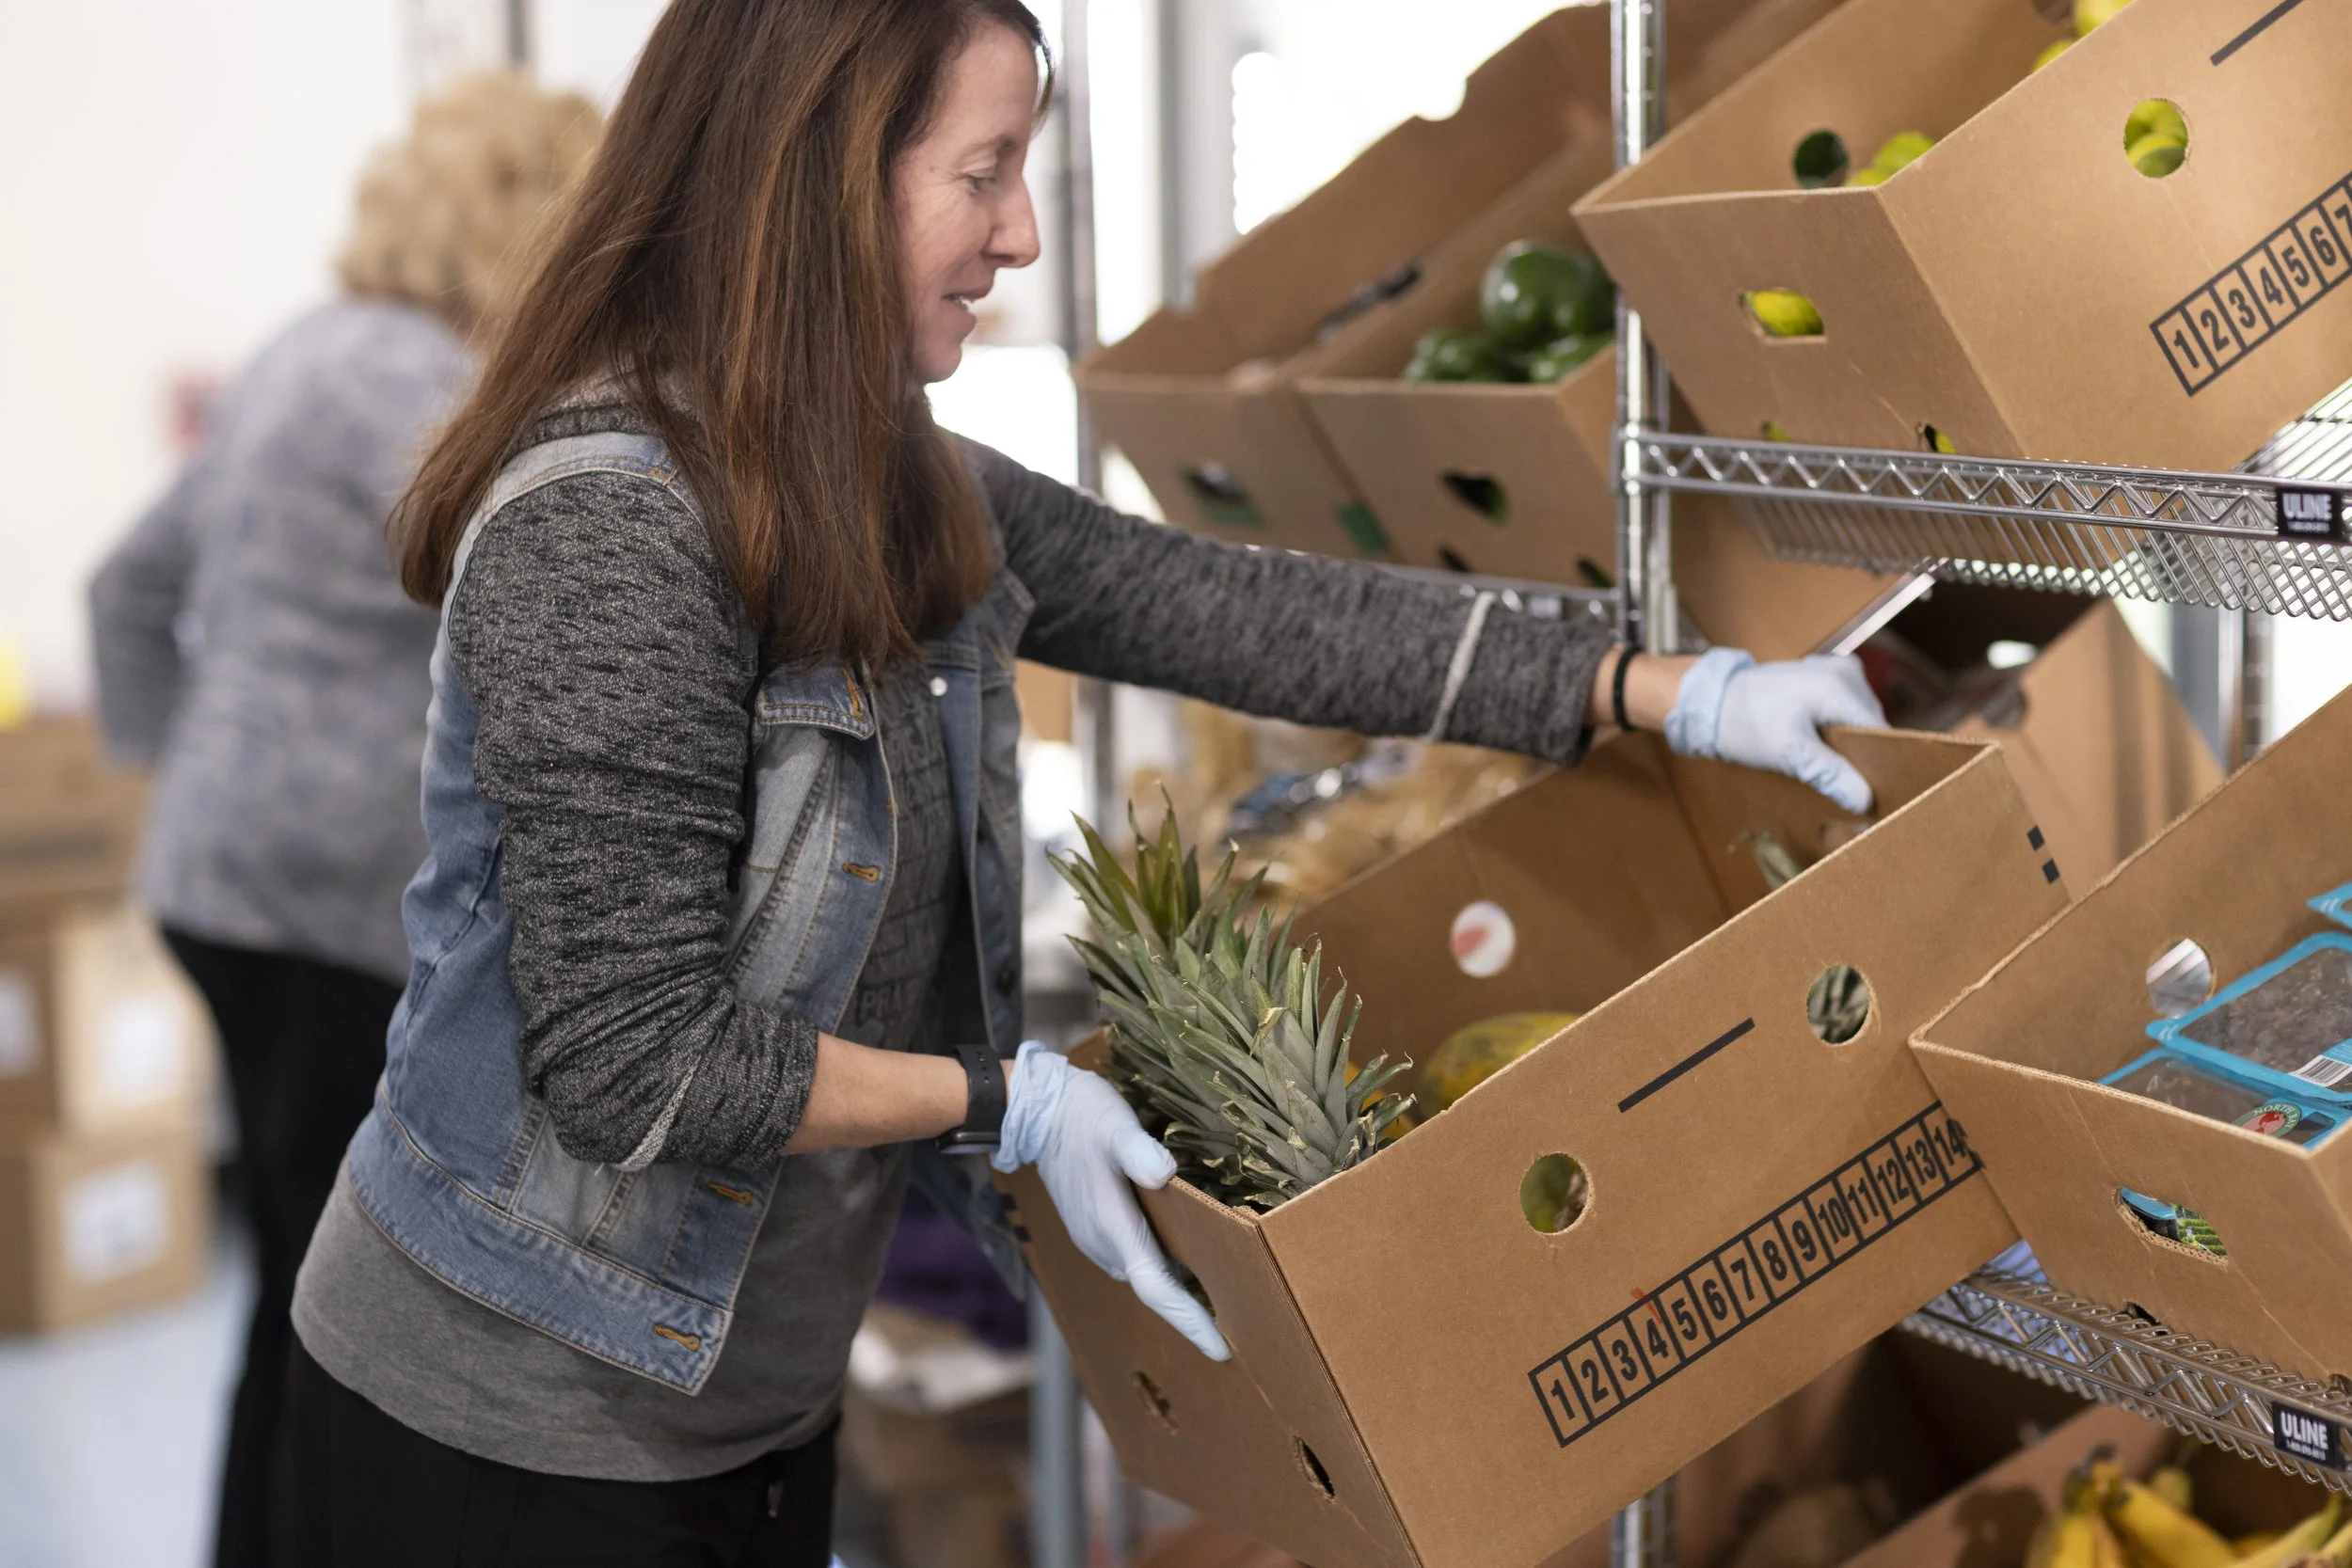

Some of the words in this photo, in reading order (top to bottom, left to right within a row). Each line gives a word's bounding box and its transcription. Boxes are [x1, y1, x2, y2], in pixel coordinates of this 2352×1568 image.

[2173, 329, 2200, 369] 1
[2200, 309, 2230, 352] 2
[2228, 288, 2256, 328] 3
[2260, 267, 2284, 306] 4
[2281, 245, 2310, 288] 5
[2310, 226, 2337, 266] 6
[2282, 492, 2332, 520] ULINE
[2253, 1103, 2293, 1117] NORTH
[2284, 1113, 2298, 1130] BAY
[1550, 1378, 1576, 1420] 1
[1581, 1358, 1610, 1404] 2
[1612, 1338, 1638, 1382] 3
[1645, 1318, 1669, 1360] 4
[1671, 1297, 1698, 1341] 5
[1702, 1278, 1728, 1322] 6
[1730, 1257, 1755, 1301] 7
[1763, 1239, 1788, 1281] 8
[1791, 1219, 1818, 1262] 9
[1818, 1196, 1851, 1244] 10
[1848, 1178, 1880, 1226] 11
[1877, 1158, 1911, 1205] 12
[1905, 1139, 1938, 1186] 13
[1934, 1118, 1968, 1165] 14
[2280, 1411, 2328, 1449] ULINE
